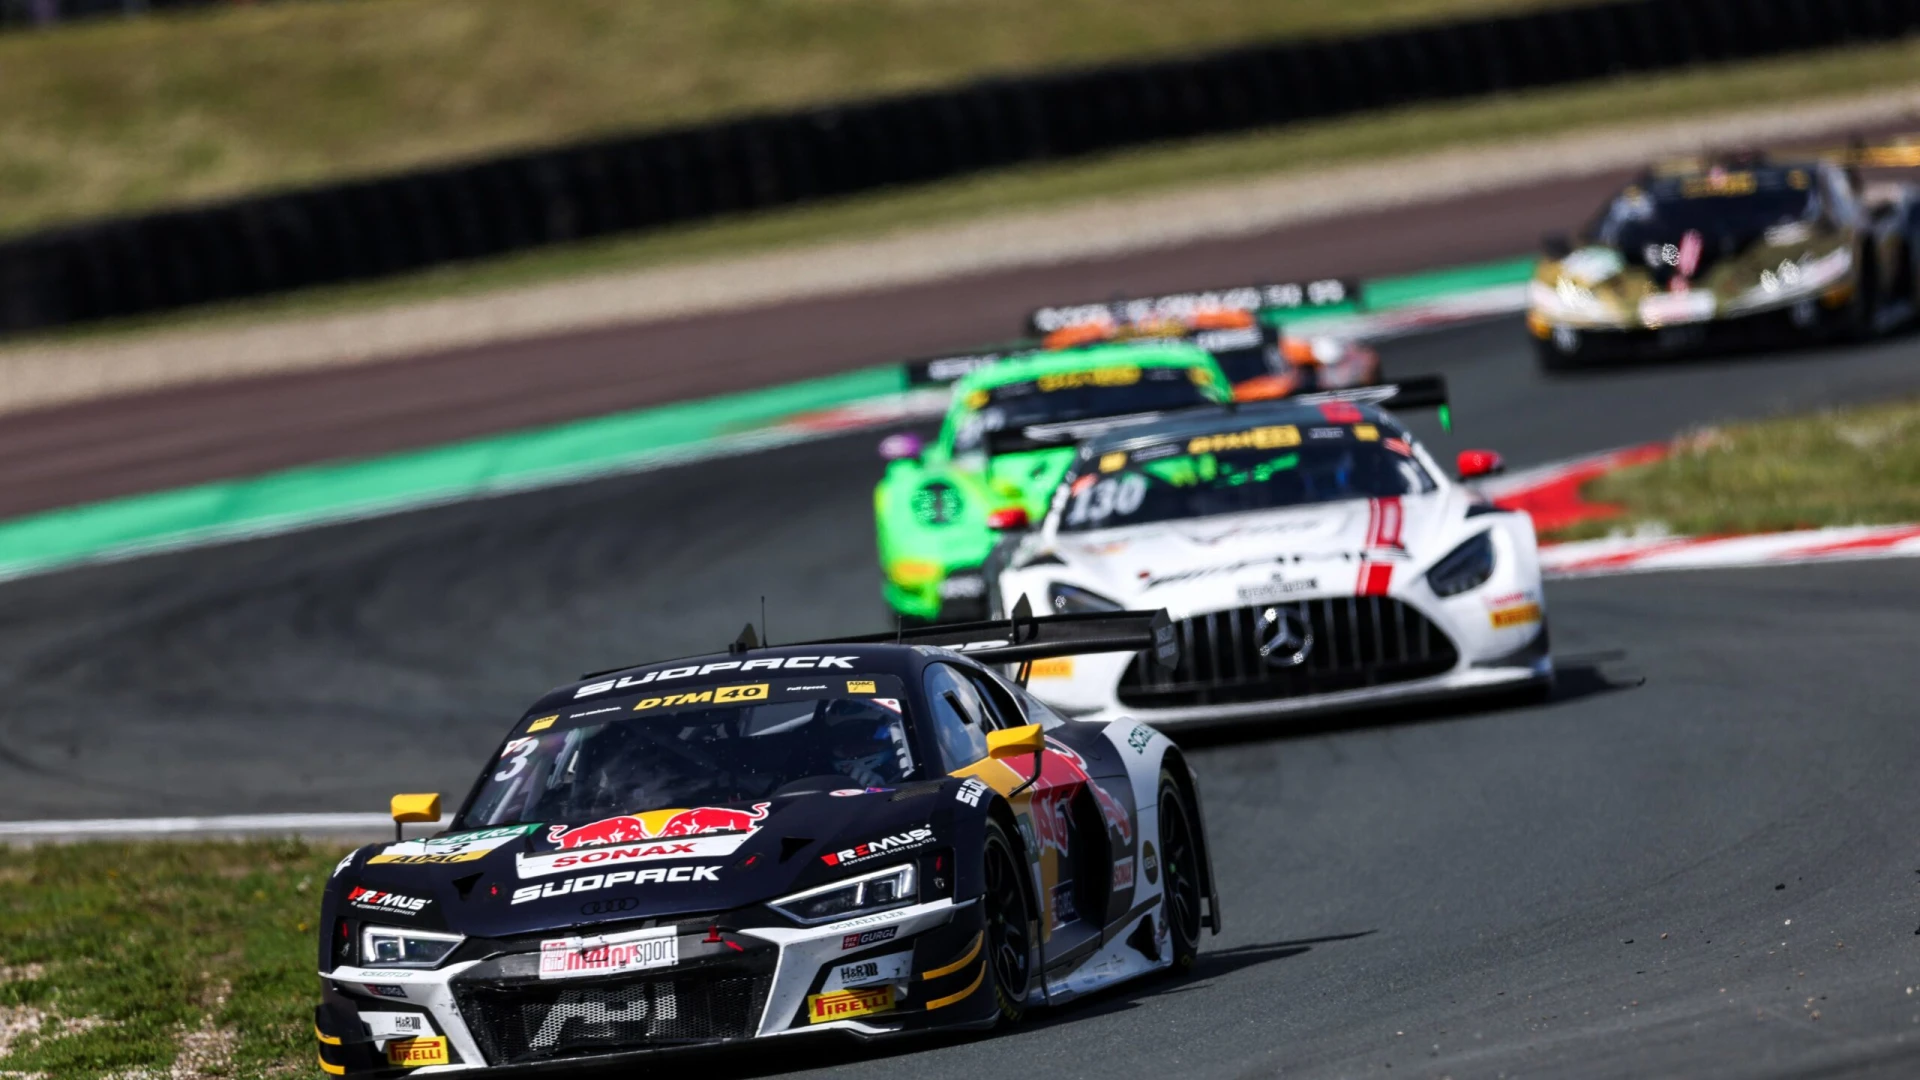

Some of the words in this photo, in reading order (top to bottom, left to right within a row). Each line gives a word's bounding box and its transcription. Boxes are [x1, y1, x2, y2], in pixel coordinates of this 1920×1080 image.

[1067, 474, 1147, 526] 130
[632, 690, 714, 711] DTM
[721, 687, 762, 699] 40
[494, 738, 540, 782] 3
[436, 842, 471, 855] 3
[551, 842, 698, 868] SONAX
[837, 828, 932, 863] REMUS
[843, 851, 887, 867] PERFORMANCE
[887, 845, 906, 855] SPORT
[390, 852, 469, 864] ADAC
[356, 890, 429, 911] REMUS
[828, 910, 907, 931] SCHAEFFLER
[861, 929, 895, 943] GURGL
[815, 988, 890, 1017] PIRELLI
[390, 1040, 441, 1061] PIRELLI
